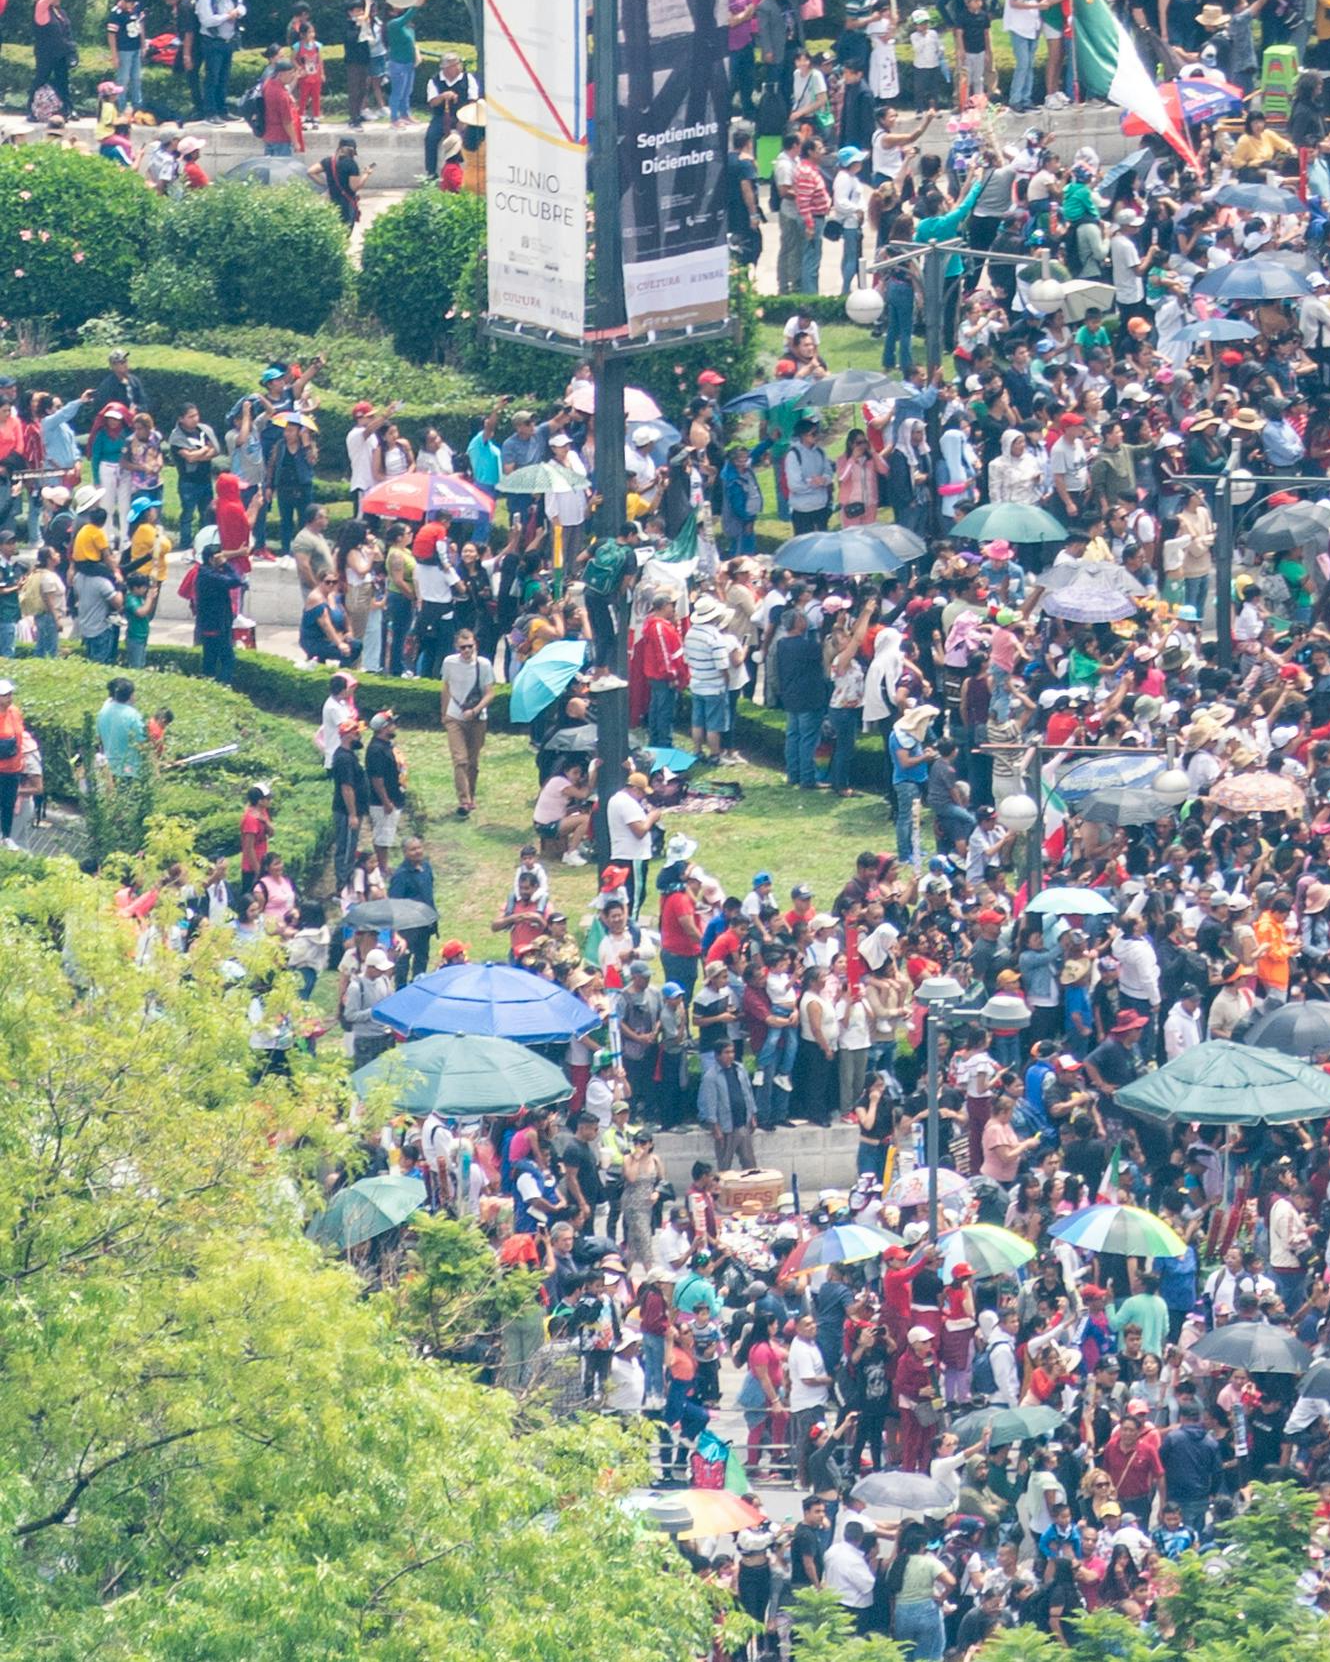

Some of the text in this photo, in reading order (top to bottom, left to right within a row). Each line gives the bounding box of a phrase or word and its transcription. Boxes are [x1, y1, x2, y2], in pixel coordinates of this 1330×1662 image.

[637, 121, 719, 149] Septiembre
[641, 148, 714, 175] Diciembre
[507, 165, 560, 194] JUNIO
[495, 192, 574, 227] OCTUBRE
